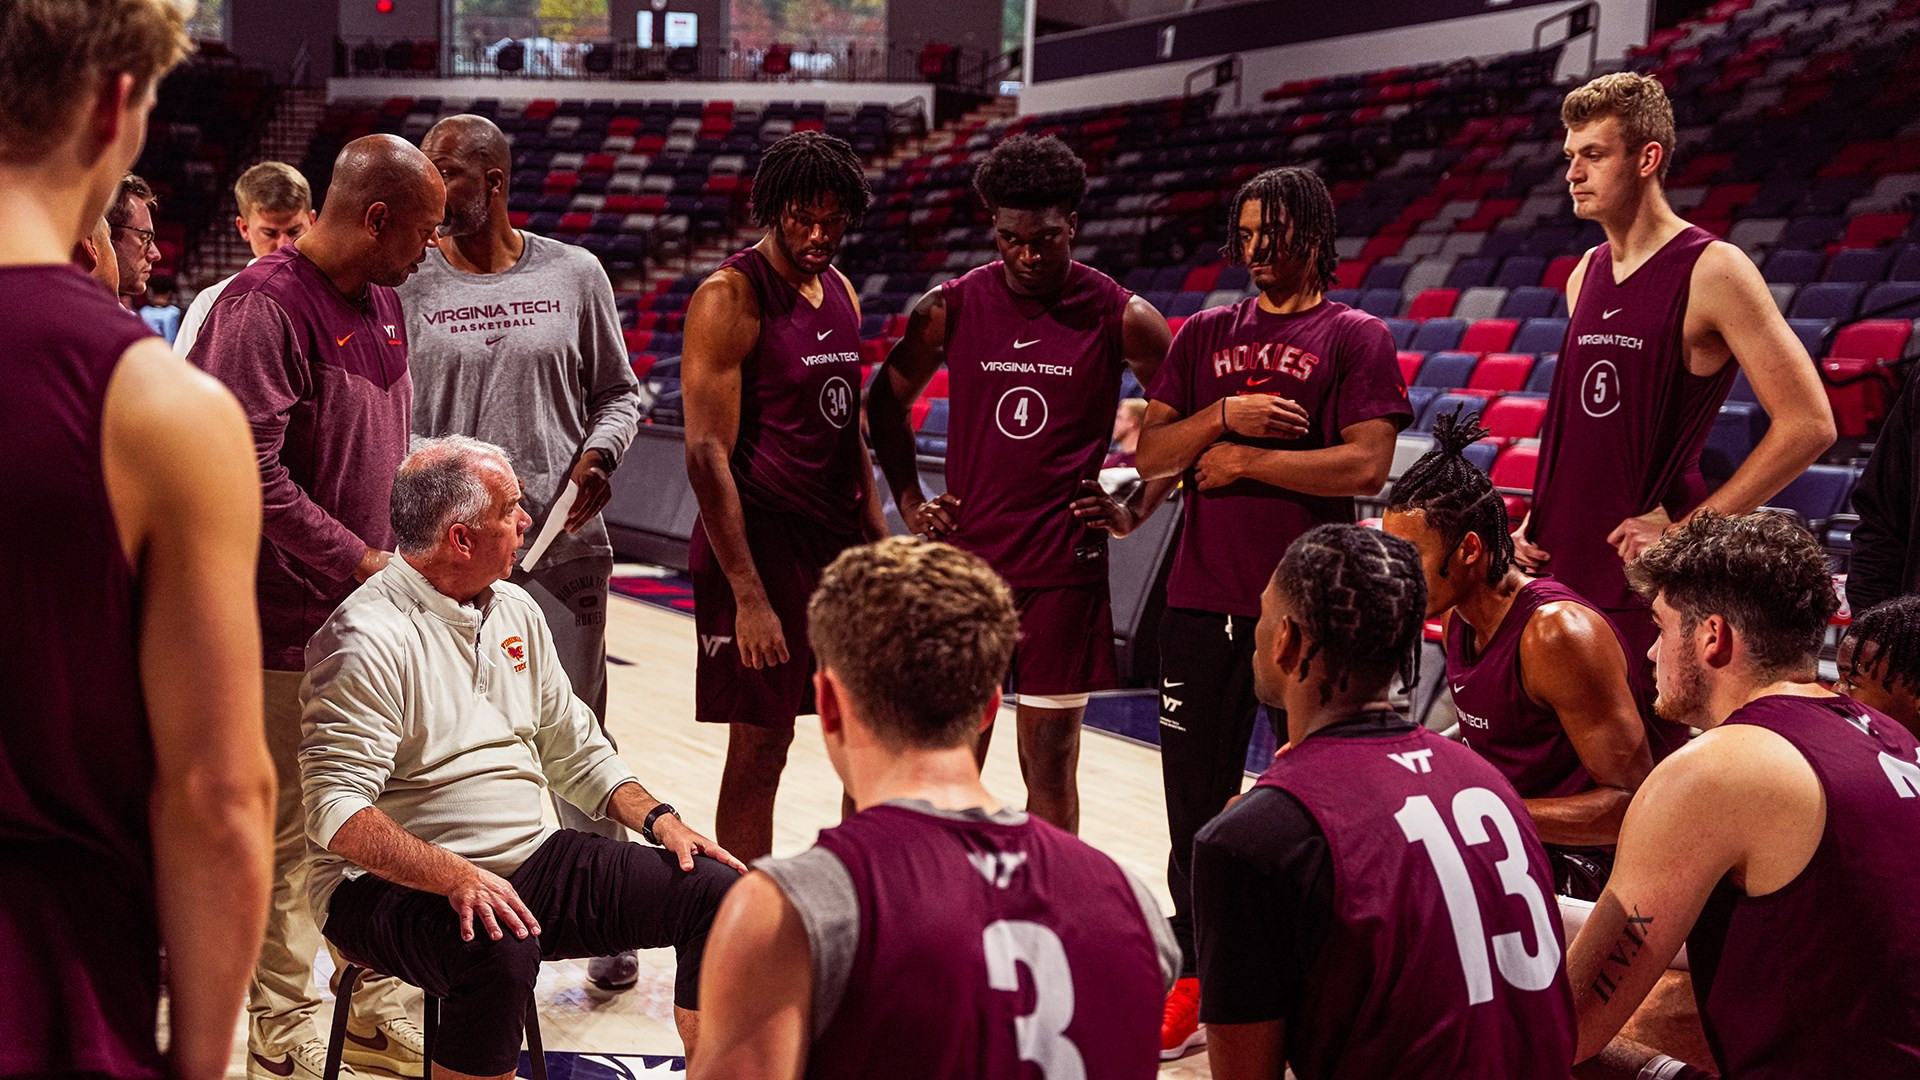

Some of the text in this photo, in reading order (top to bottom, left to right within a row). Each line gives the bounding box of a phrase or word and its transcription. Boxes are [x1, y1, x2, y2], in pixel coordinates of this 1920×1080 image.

[423, 300, 561, 325] VIRGINIA TECH
[450, 318, 535, 334] BASKETBALL
[1577, 334, 1643, 350] VIRGINIA TECH
[801, 352, 859, 366] VIRGINIA TECH
[981, 361, 1073, 376] VIRGINIA TECH
[1213, 342, 1319, 382] HOKIES
[1593, 372, 1607, 403] 5
[827, 387, 847, 417] 34
[1014, 397, 1028, 428] 4
[575, 611, 603, 627] HOKIES
[701, 634, 733, 657] VT
[1162, 694, 1183, 712] VT
[1467, 713, 1489, 729] TECH
[1387, 749, 1433, 774] VT
[1394, 787, 1561, 1006] 13
[982, 919, 1088, 1080] 3
